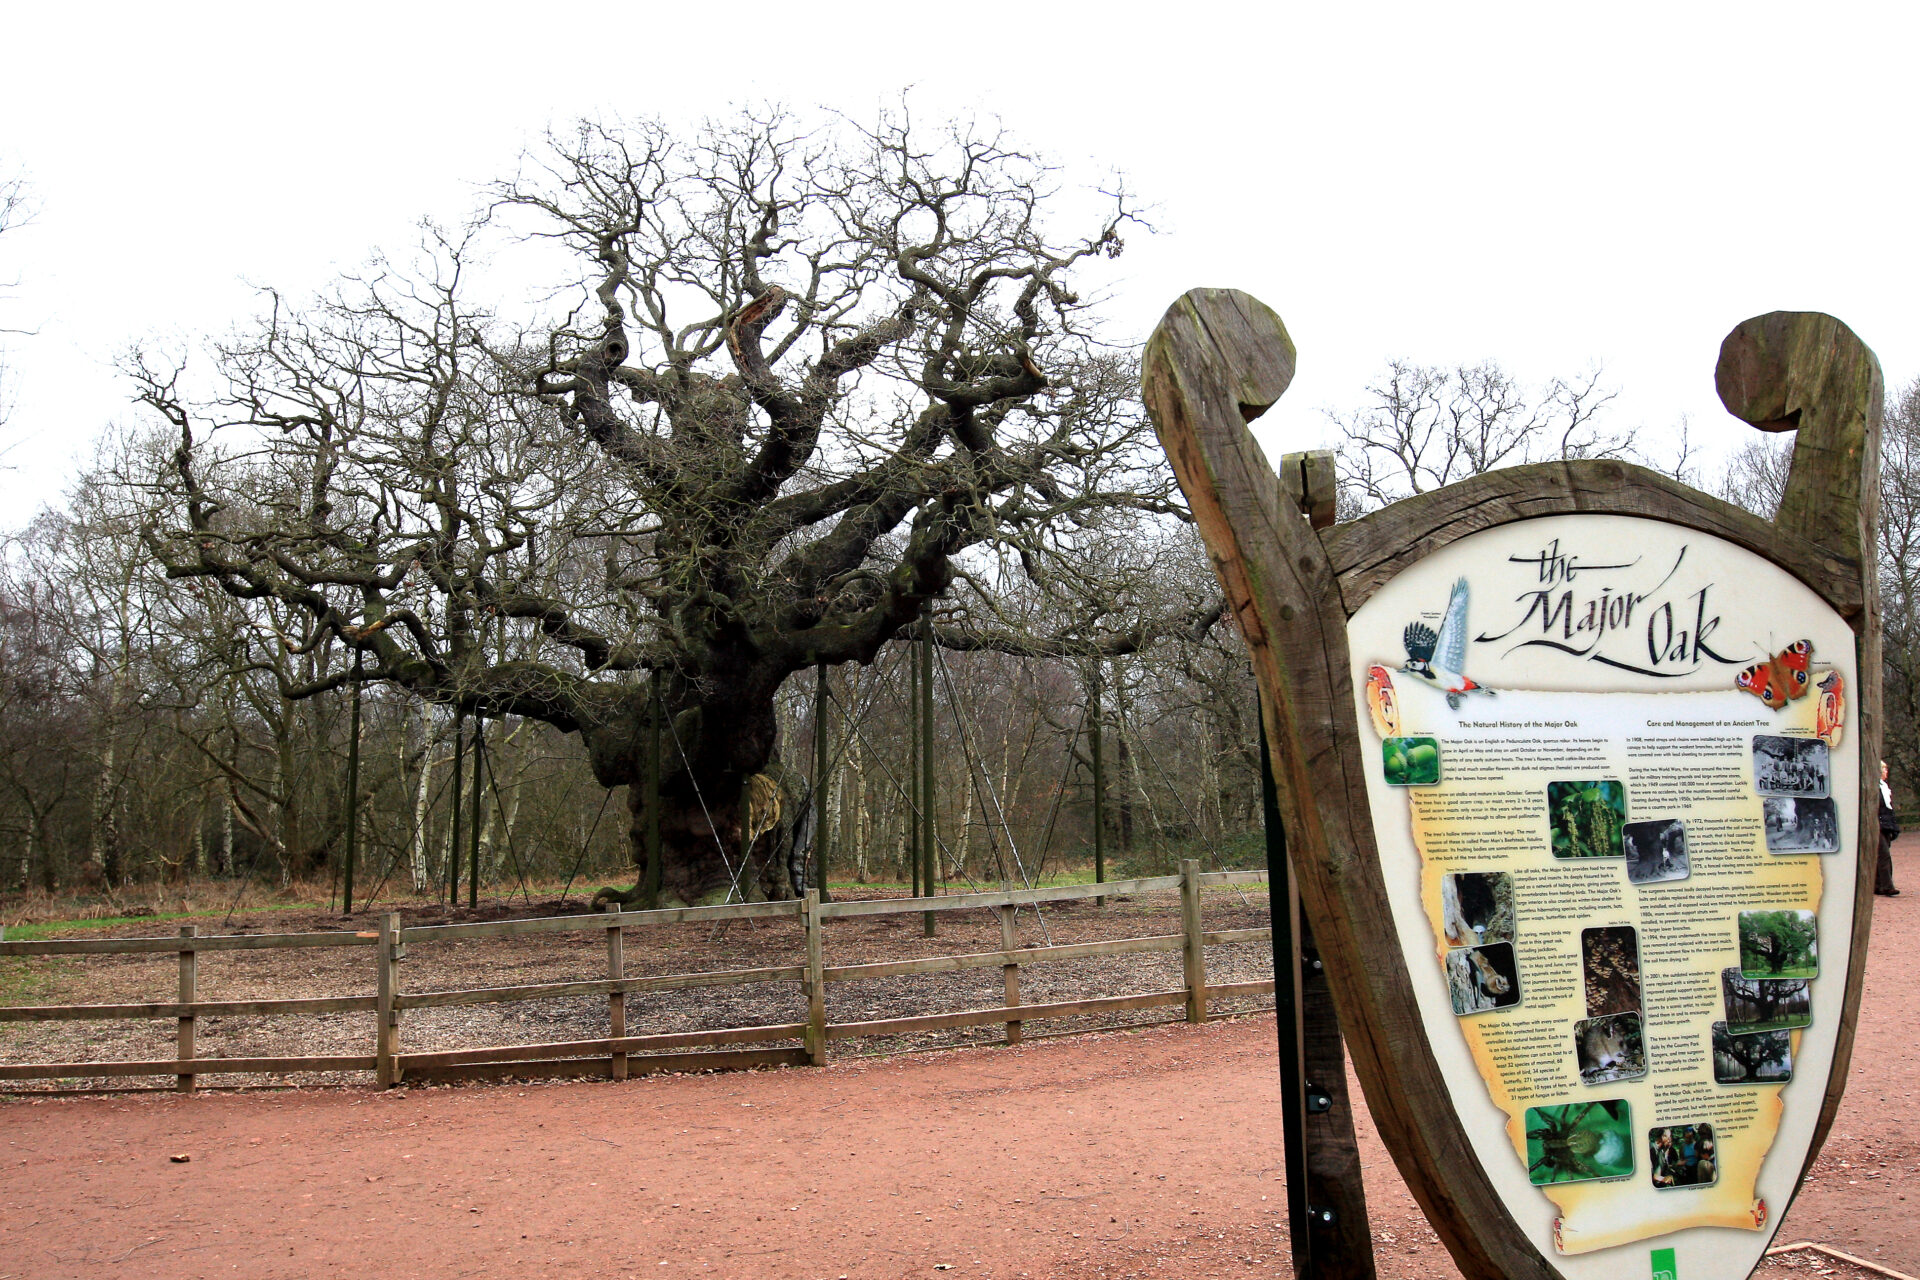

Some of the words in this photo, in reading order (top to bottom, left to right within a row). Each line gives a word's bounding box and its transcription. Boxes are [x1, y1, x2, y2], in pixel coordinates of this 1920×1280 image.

[1508, 538, 1642, 585] the
[1647, 583, 1756, 672] Oak
[1499, 721, 1522, 729] History
[1544, 721, 1563, 729] Major
[1675, 720, 1715, 728] Management
